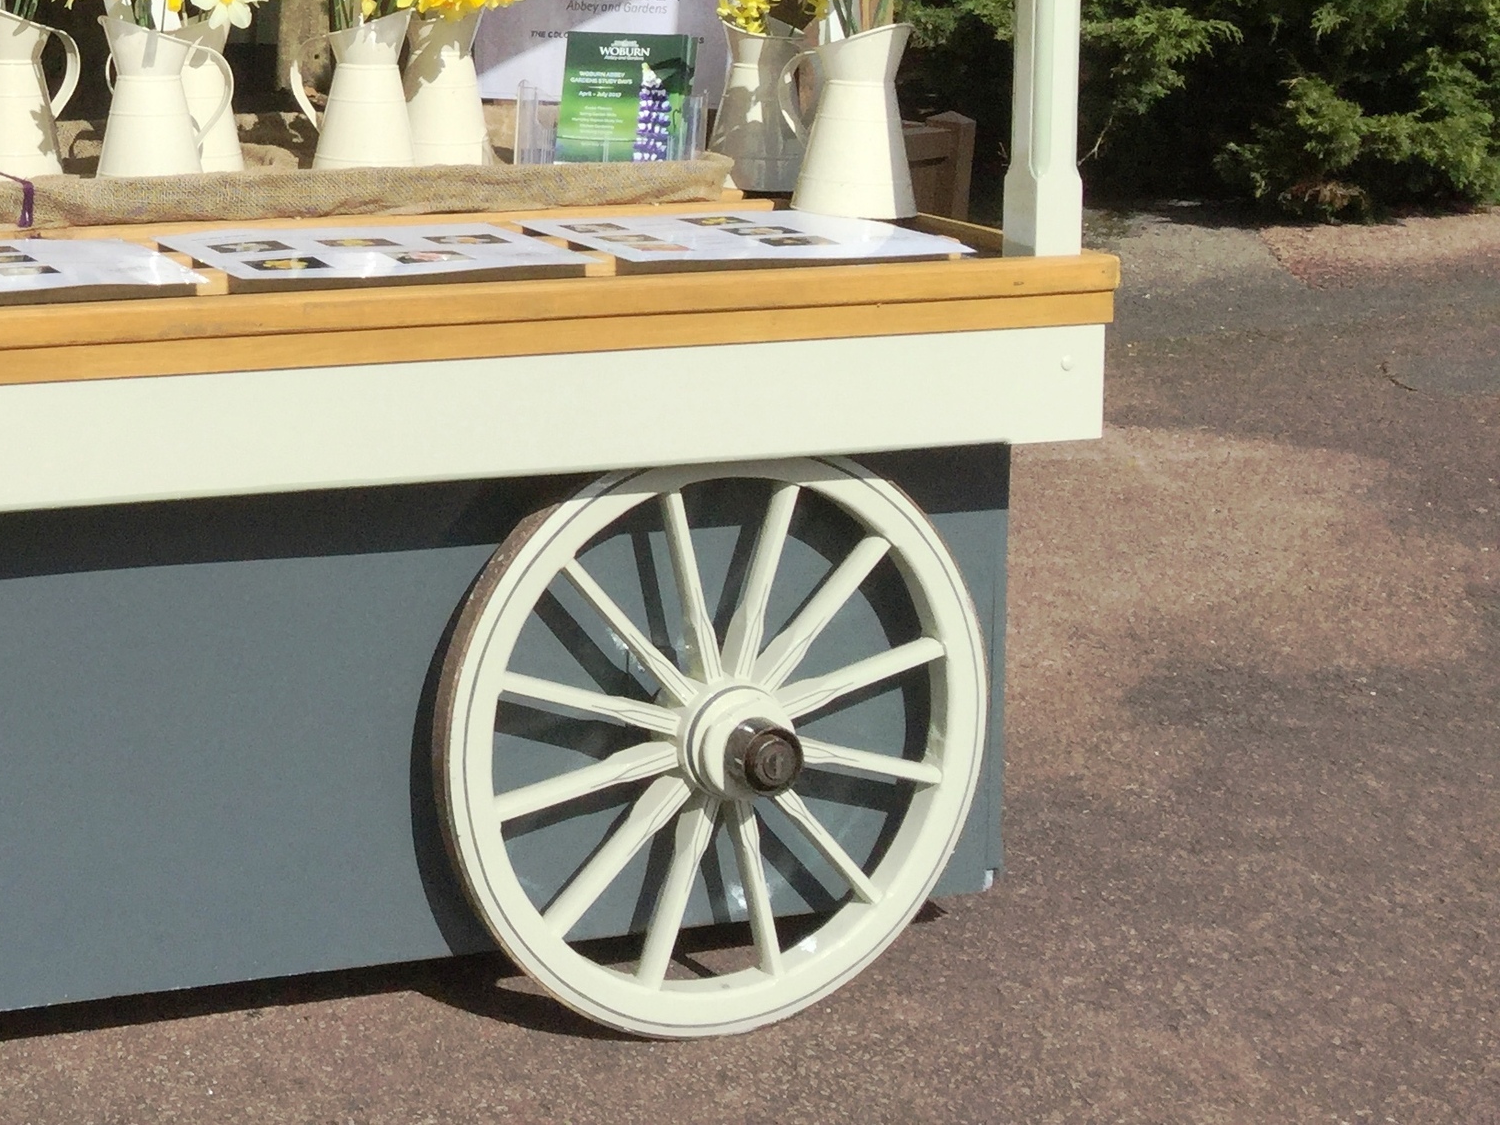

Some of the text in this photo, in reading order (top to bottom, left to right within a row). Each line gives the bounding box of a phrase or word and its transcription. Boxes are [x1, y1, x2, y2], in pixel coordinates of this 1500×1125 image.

[566, 0, 668, 14] Abbey and Gardens
[599, 46, 651, 56] WOBURN
